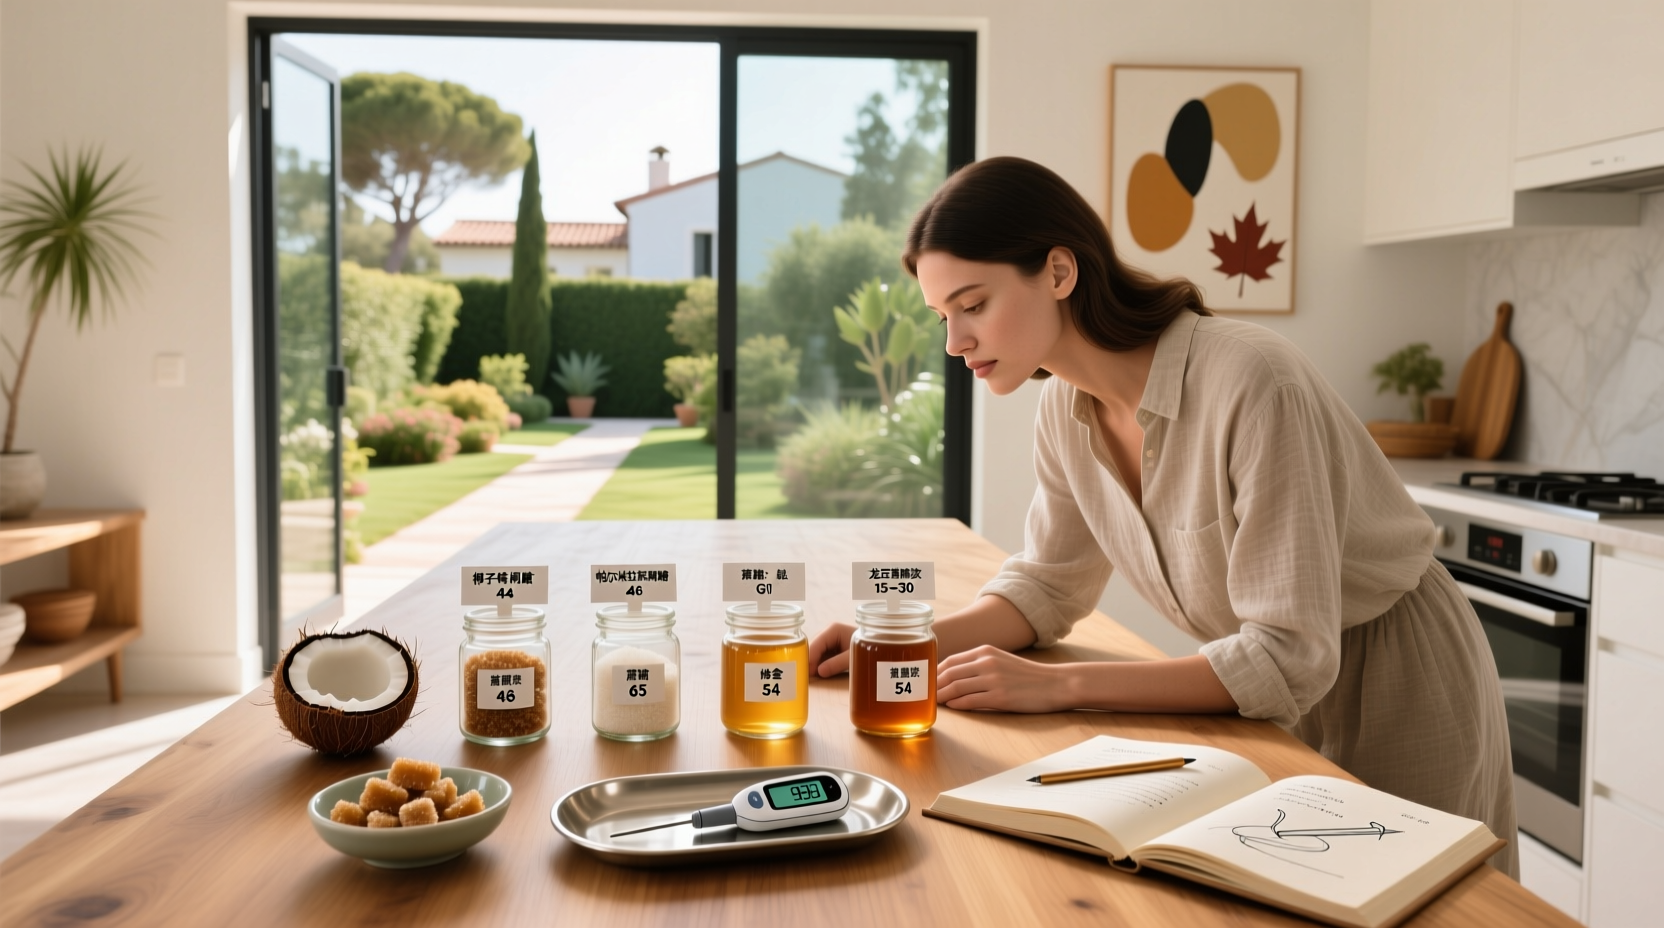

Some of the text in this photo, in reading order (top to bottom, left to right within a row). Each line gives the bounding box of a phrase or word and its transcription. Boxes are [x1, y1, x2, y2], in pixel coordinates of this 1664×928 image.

[496, 587, 514, 599] 44
[625, 585, 643, 596] 46
[628, 684, 647, 697] 65
[761, 683, 781, 697] 54
[894, 682, 912, 695] 54
[495, 689, 516, 703] 46
